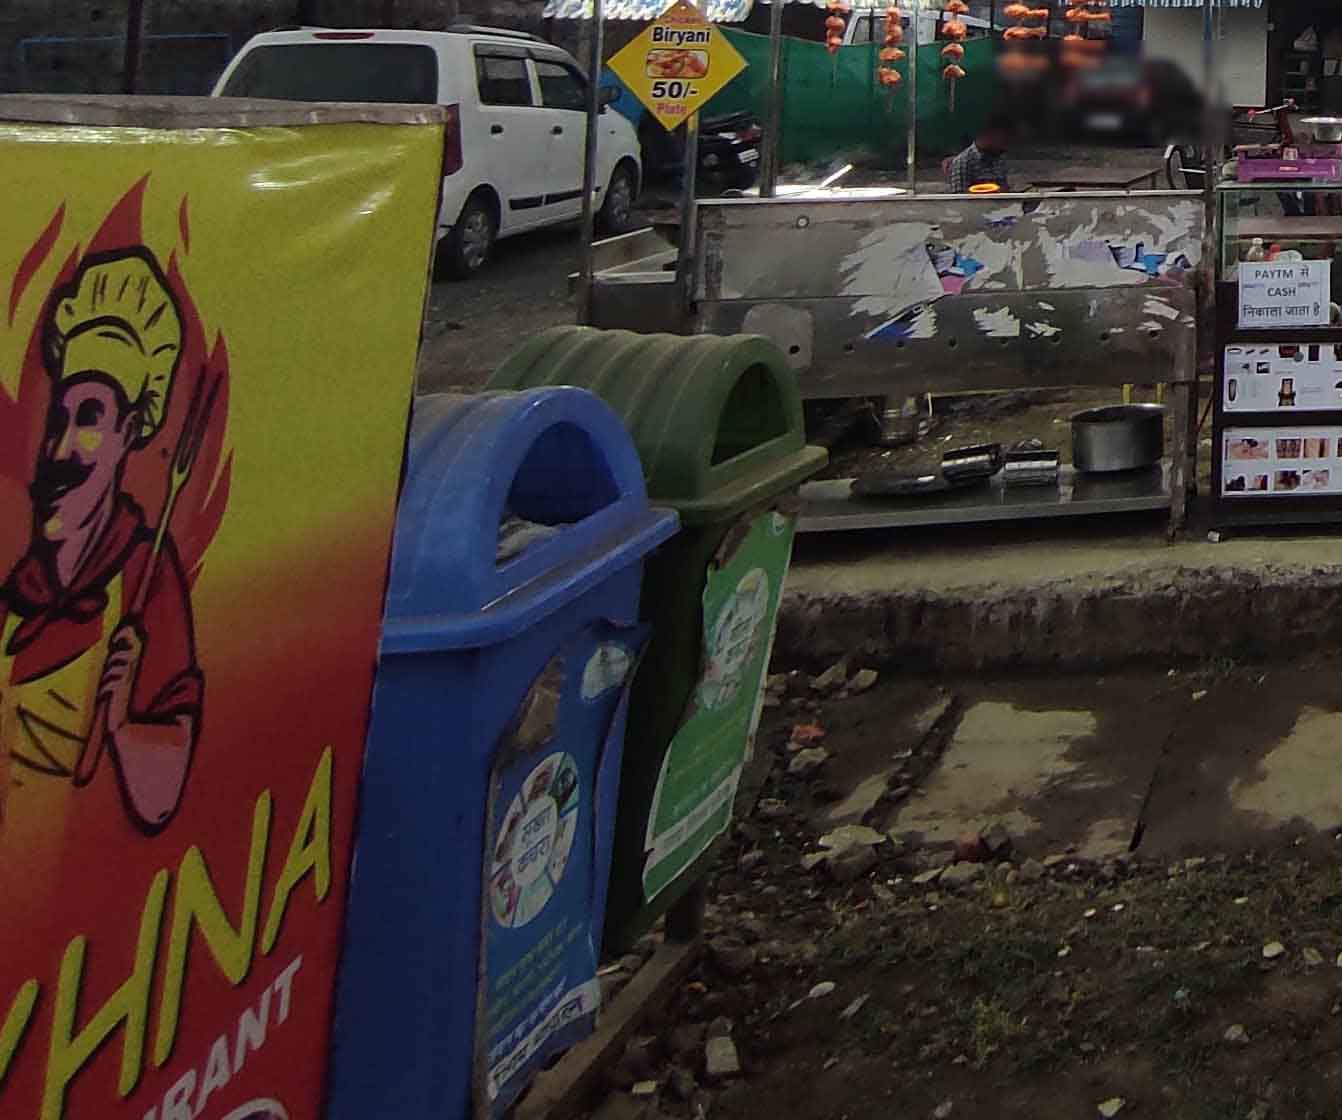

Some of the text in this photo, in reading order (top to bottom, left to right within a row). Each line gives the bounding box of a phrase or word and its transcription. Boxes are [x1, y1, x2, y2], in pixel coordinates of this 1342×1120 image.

[652, 27, 710, 46] Biryani
[652, 81, 698, 98] 50/-
[1255, 269, 1294, 280] PAYTM
[1267, 287, 1296, 297] CASH
